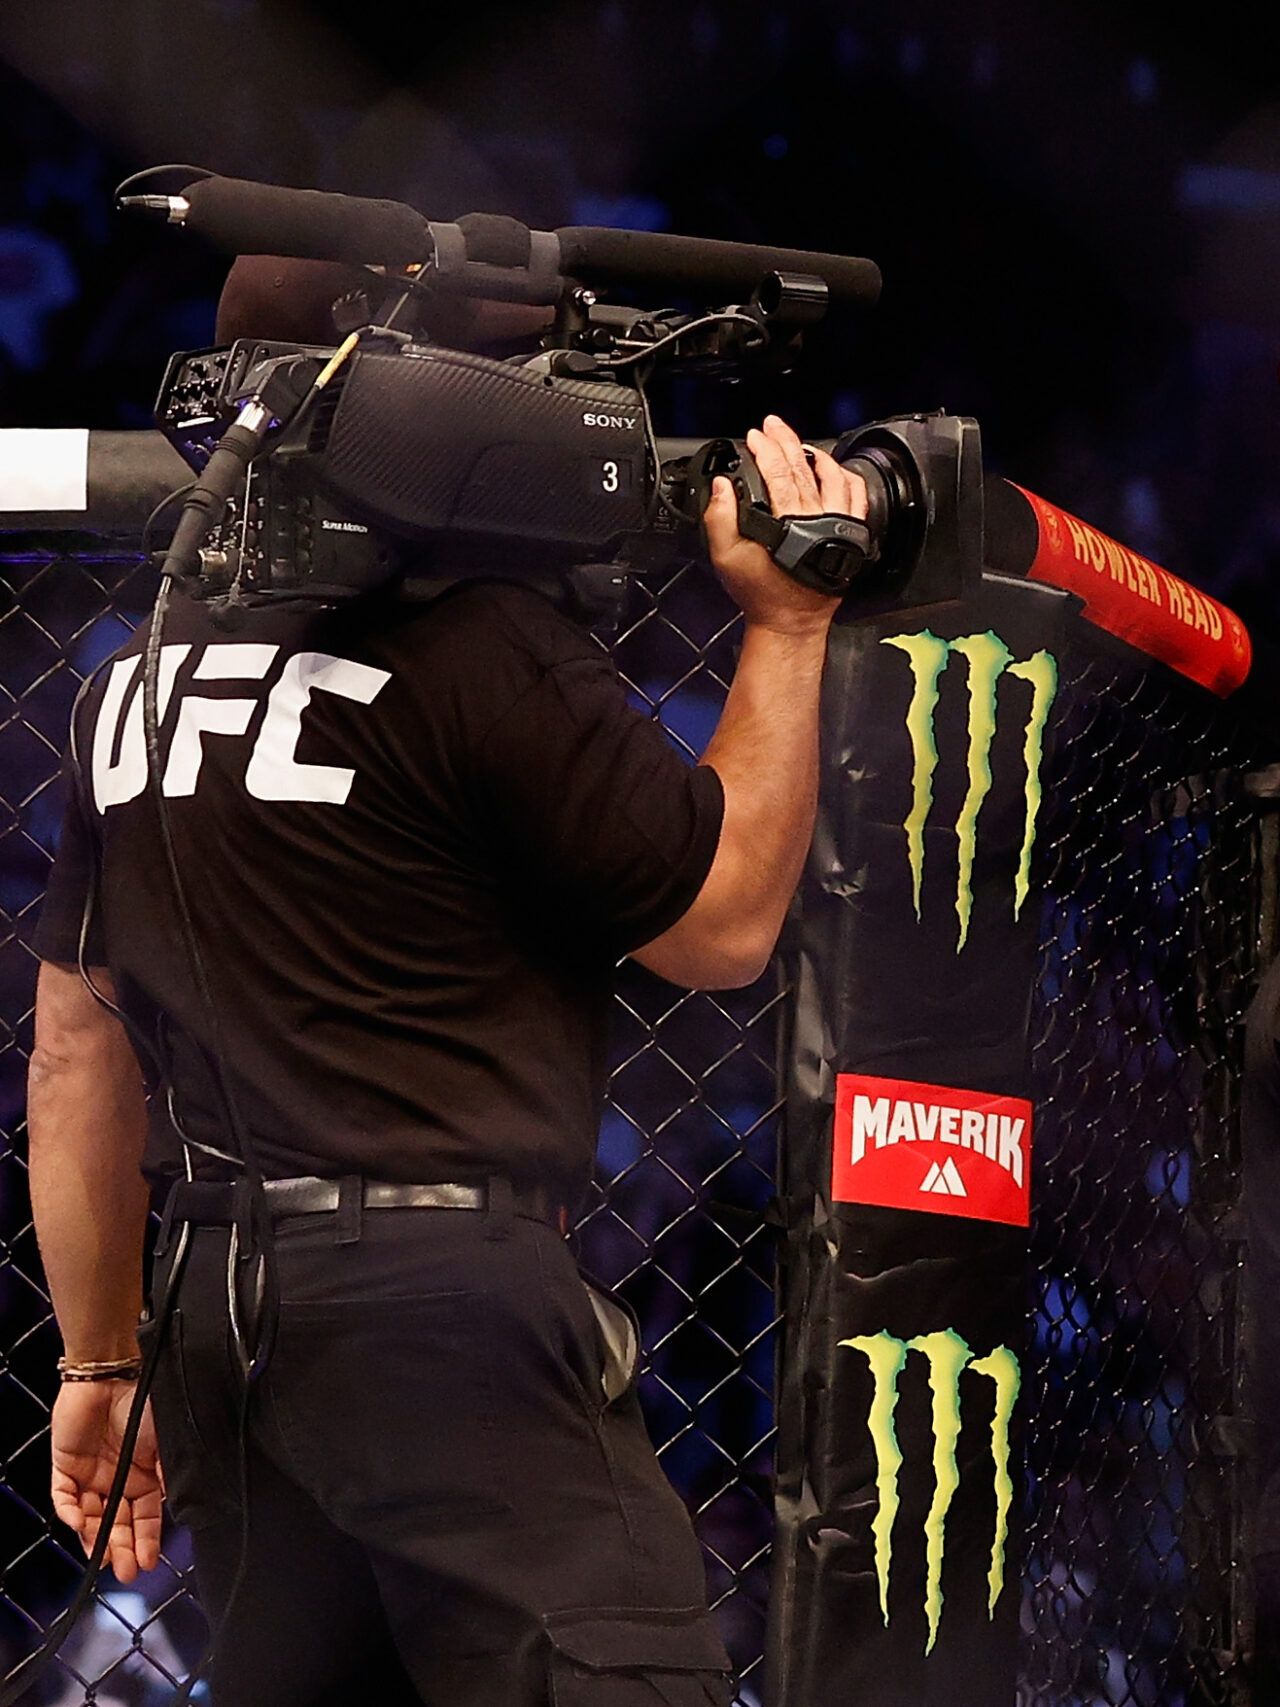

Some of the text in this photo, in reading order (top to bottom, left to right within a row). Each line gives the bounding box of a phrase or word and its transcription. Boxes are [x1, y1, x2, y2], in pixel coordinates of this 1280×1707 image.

[583, 413, 636, 430] SONY
[602, 461, 618, 492] 3
[1063, 515, 1223, 640] HOWLER HEAD
[92, 644, 392, 815] UFC
[851, 1094, 1025, 1190] MAVERIK
